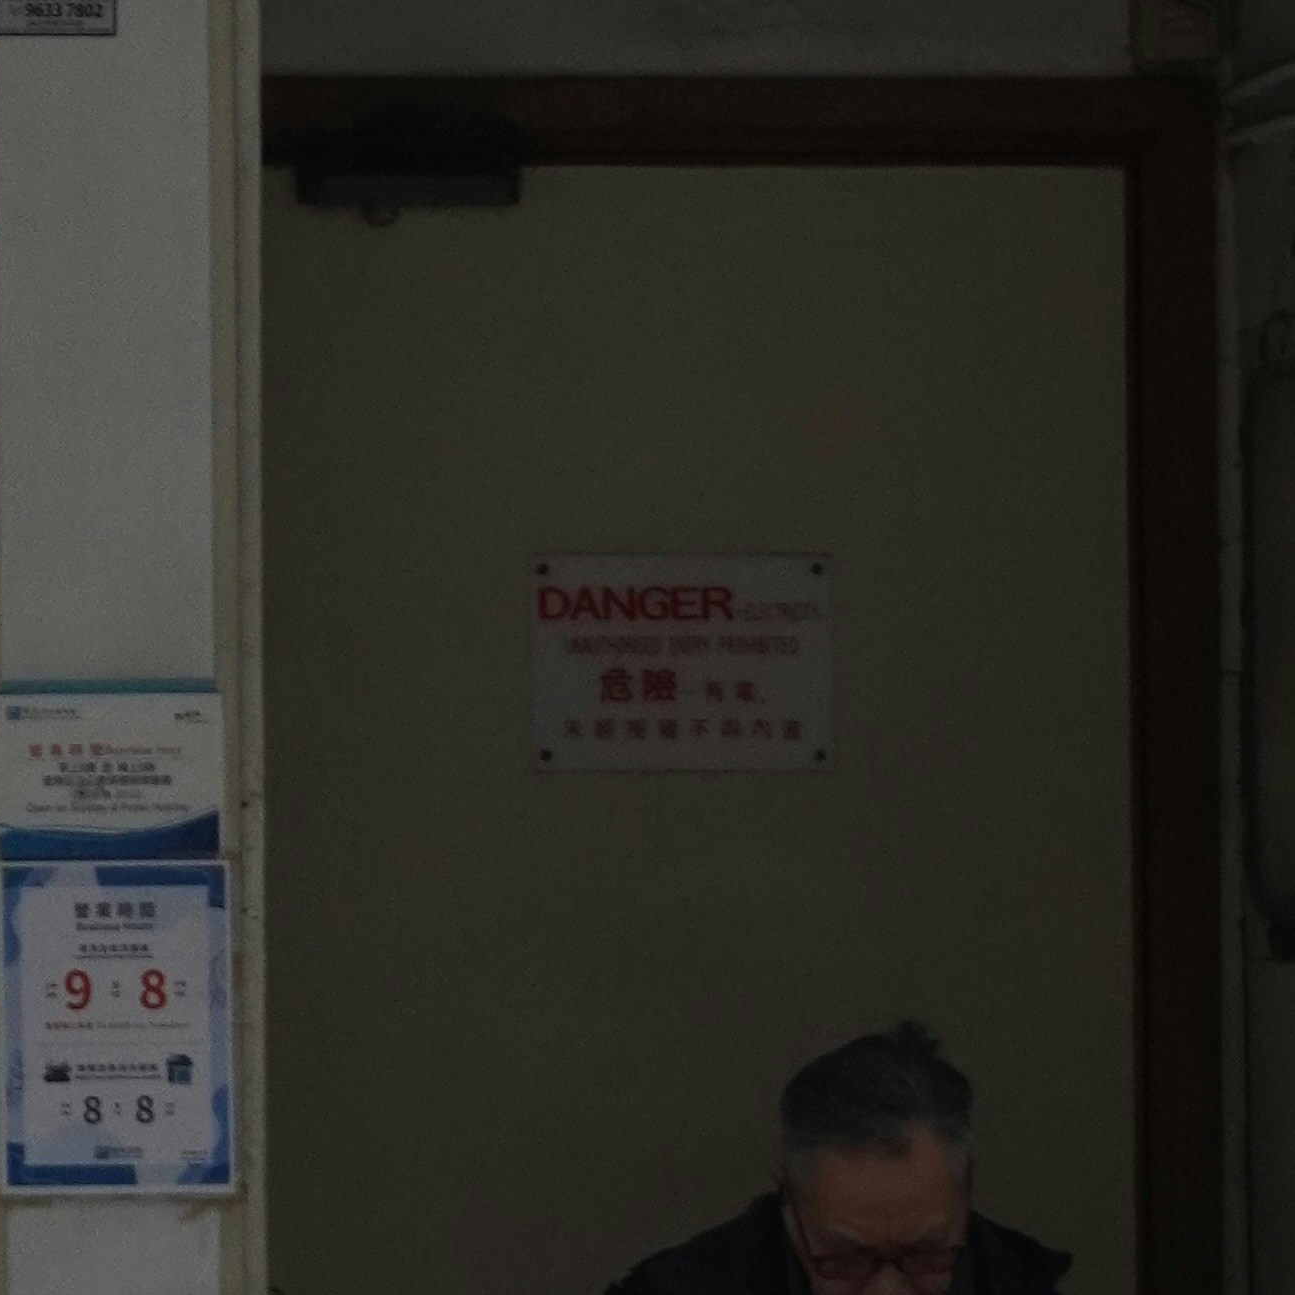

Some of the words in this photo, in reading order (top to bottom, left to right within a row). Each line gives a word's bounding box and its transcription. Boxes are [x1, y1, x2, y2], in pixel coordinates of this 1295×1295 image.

[537, 586, 734, 621] DANGER
[600, 668, 676, 703] 危險
[63, 968, 92, 1011] 9
[139, 968, 167, 1010] 8
[83, 1096, 102, 1124] 8
[135, 1095, 155, 1124] 8
